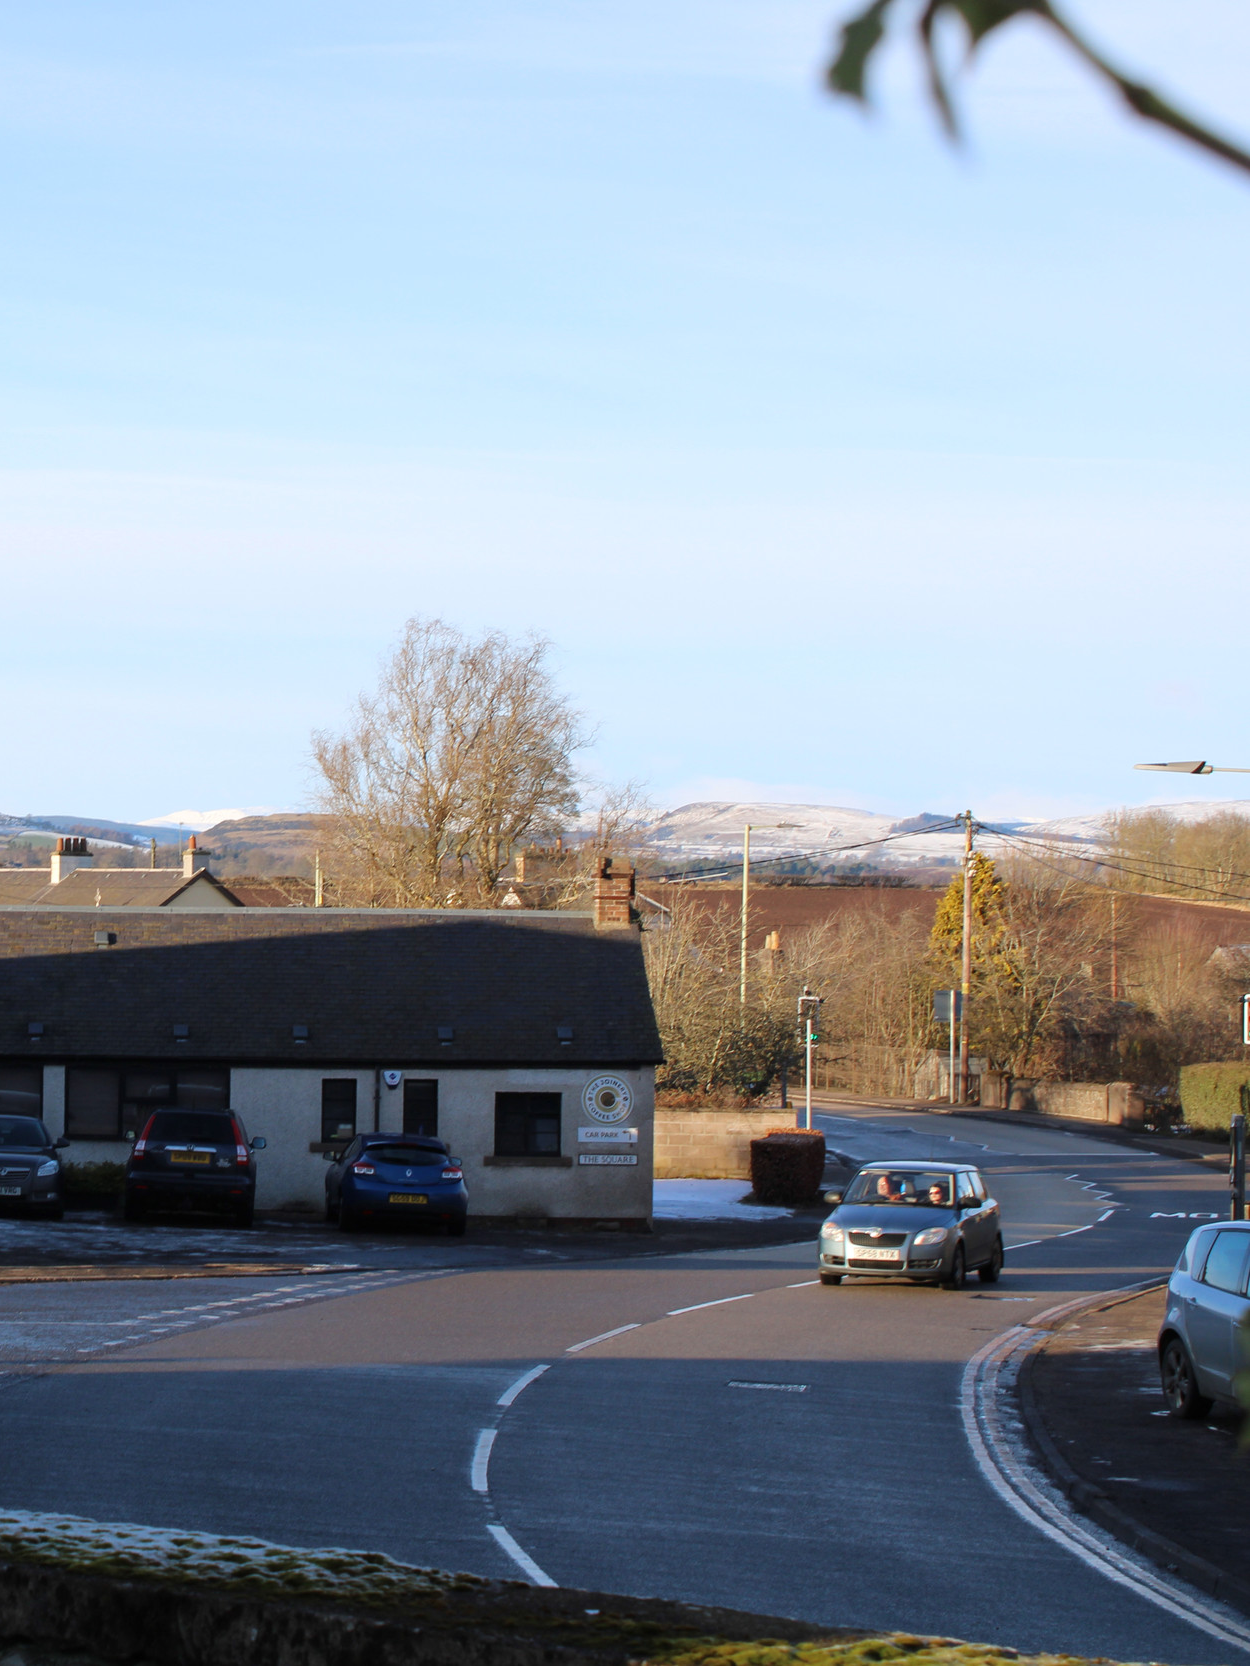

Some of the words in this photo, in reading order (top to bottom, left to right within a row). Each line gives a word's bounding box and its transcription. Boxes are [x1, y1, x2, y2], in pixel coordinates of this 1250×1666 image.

[588, 1083, 599, 1096] THE
[601, 1078, 629, 1095] JOINERY
[588, 1102, 610, 1120] COFFEE
[583, 1156, 599, 1164] THE
[601, 1156, 634, 1164] SQUARE
